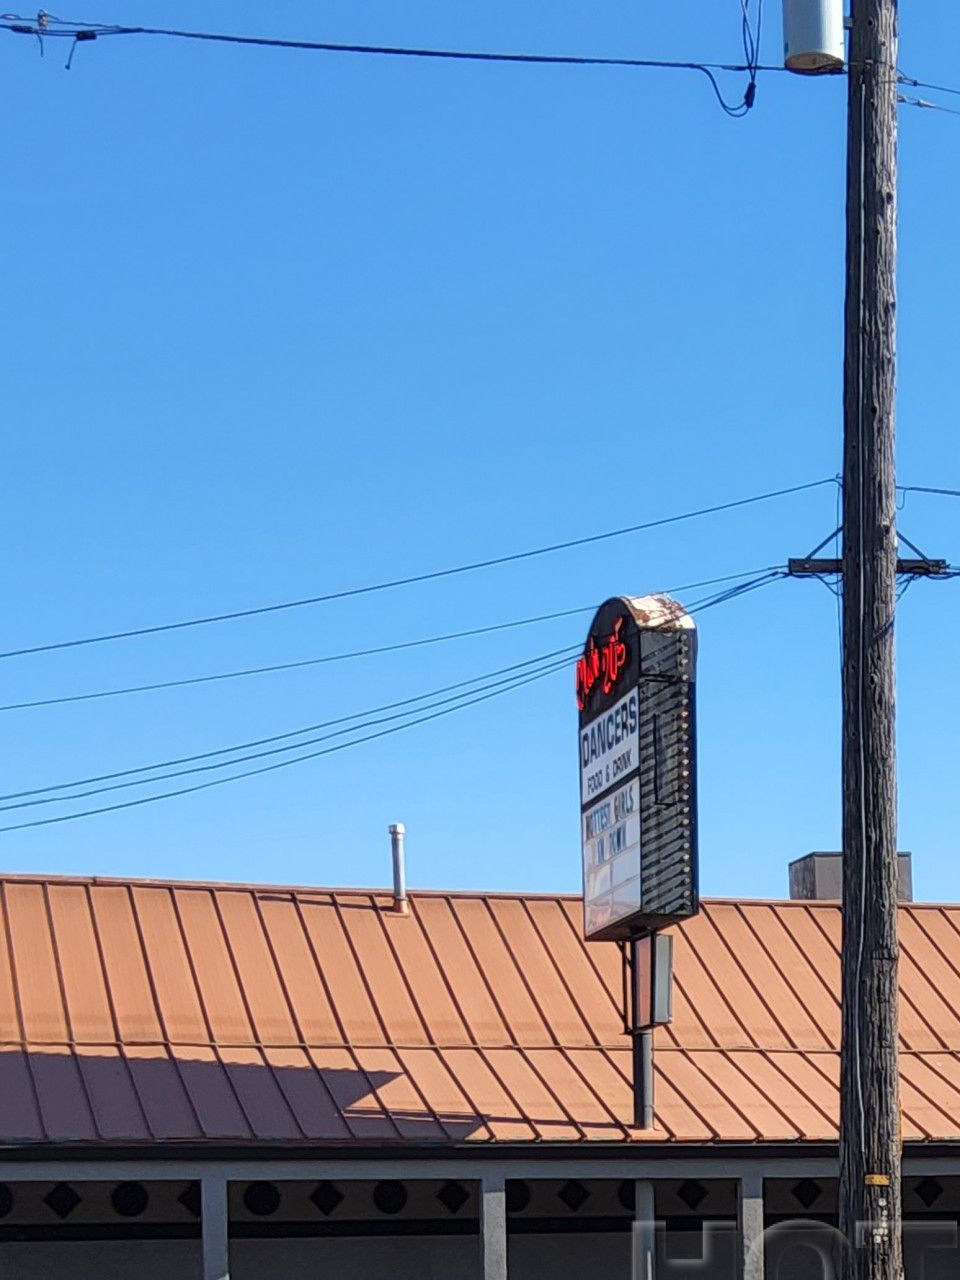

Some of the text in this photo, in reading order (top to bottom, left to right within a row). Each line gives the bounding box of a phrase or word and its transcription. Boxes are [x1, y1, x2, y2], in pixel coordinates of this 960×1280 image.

[582, 695, 638, 768] DANCERS
[587, 769, 603, 795] FOOD
[613, 749, 632, 778] DRINK
